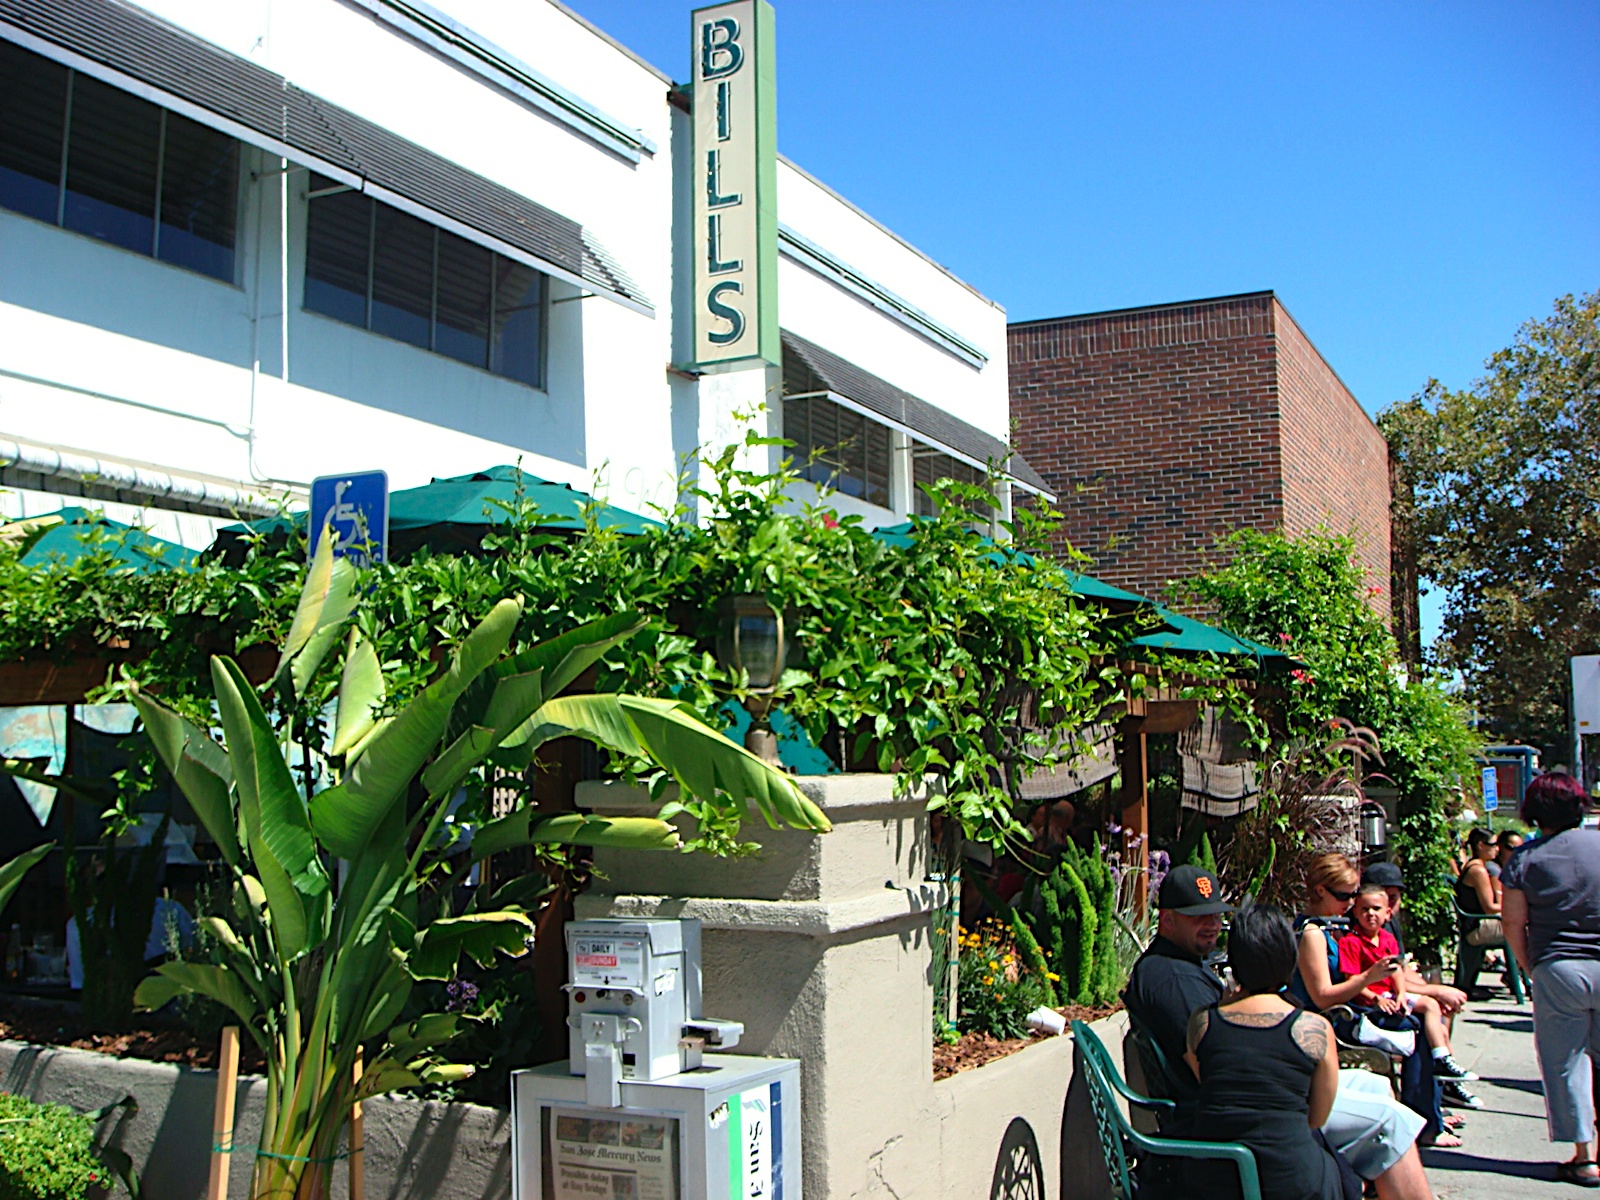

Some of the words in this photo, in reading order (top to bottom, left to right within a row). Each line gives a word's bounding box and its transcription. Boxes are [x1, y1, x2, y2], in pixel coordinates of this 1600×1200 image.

[699, 18, 745, 348] BILLS
[591, 943, 611, 953] DAILY
[560, 1142, 575, 1154] San
[576, 1145, 596, 1157] Jose
[596, 1147, 636, 1163] Mercury
[636, 1150, 662, 1163] News
